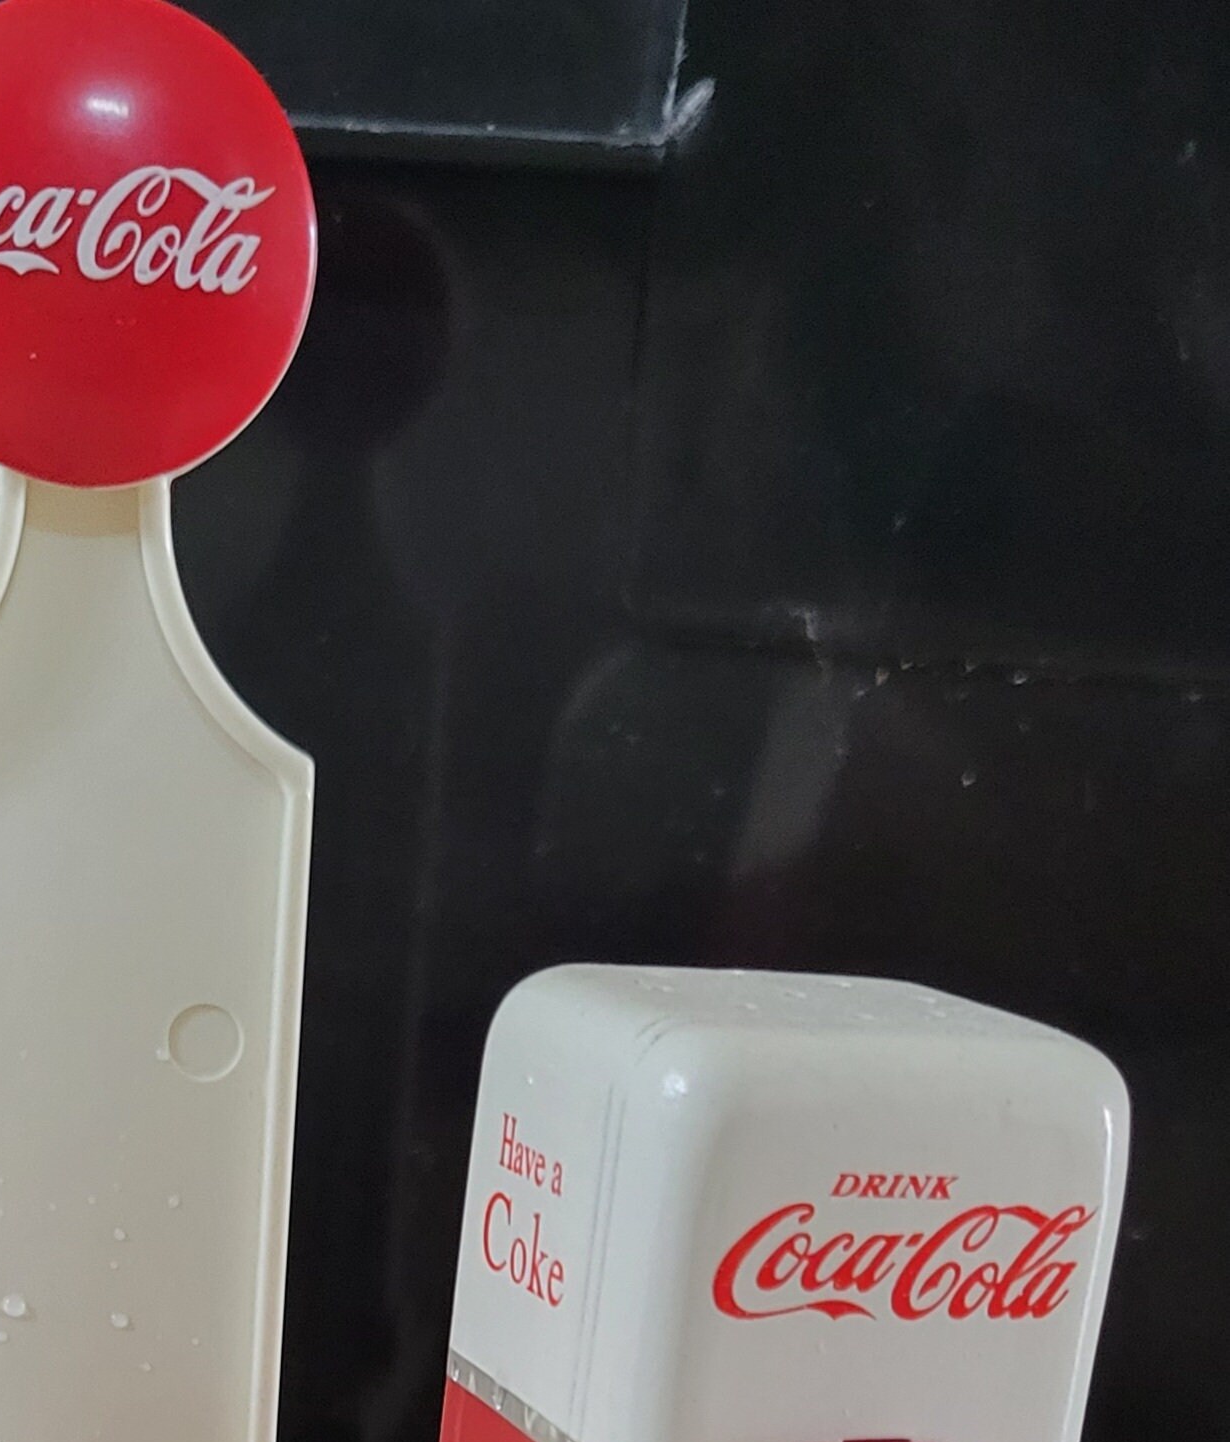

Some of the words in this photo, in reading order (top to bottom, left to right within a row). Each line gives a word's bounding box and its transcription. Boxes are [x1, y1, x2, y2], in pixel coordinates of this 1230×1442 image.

[499, 1112, 546, 1188] Have
[551, 1161, 563, 1197] a
[830, 1172, 959, 1201] DRINK
[483, 1191, 565, 1308] Coke
[712, 1202, 1099, 1322] Coca-Cola
